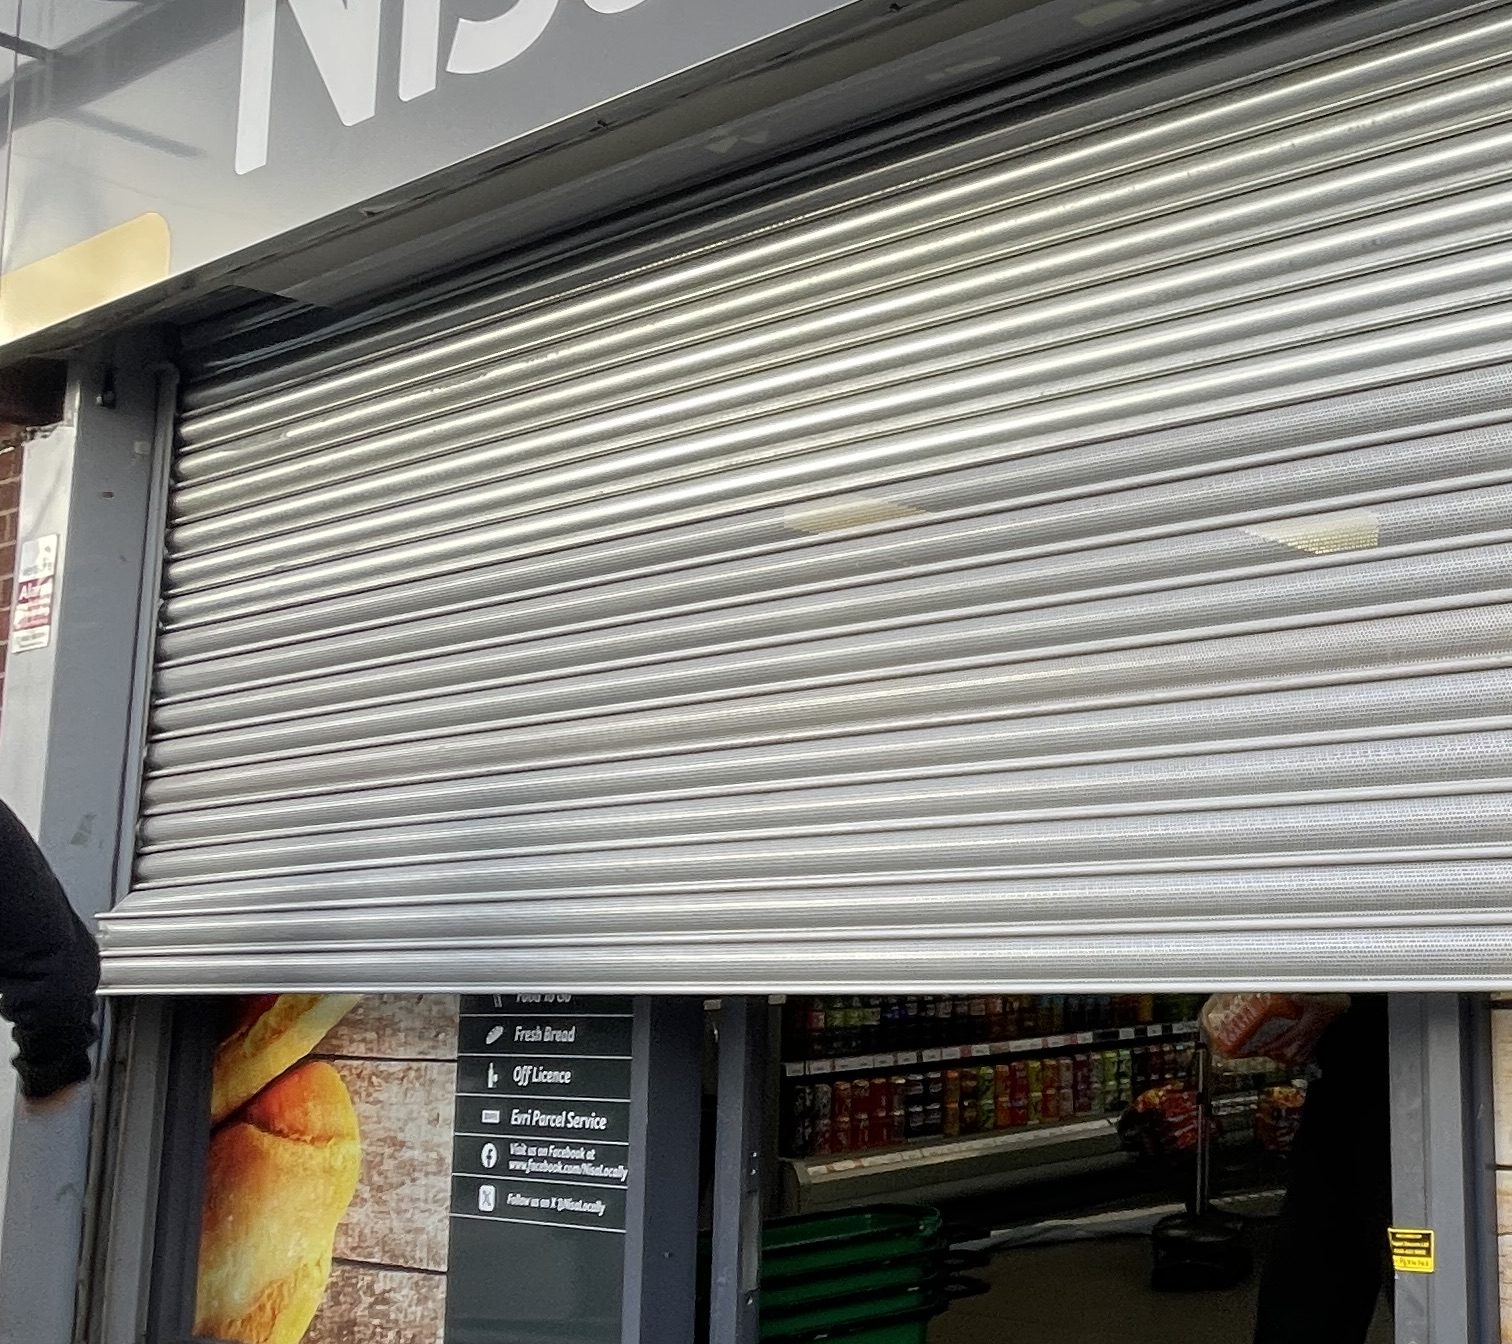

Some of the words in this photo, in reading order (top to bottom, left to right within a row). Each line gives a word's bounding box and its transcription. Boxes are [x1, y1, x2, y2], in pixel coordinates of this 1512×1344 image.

[513, 1025, 542, 1042] Fresh
[543, 1025, 576, 1043] Bread
[512, 1065, 533, 1087] Off
[531, 1066, 572, 1084] Licence
[510, 1108, 531, 1126] Evri
[531, 1109, 566, 1128] Parcel
[566, 1111, 607, 1130] Service
[509, 1142, 528, 1156] Visit
[527, 1146, 537, 1157] us
[537, 1147, 548, 1157] on
[548, 1144, 585, 1159] Facebook
[585, 1148, 596, 1161] at
[506, 1192, 530, 1206] Follow
[530, 1197, 540, 1208] us
